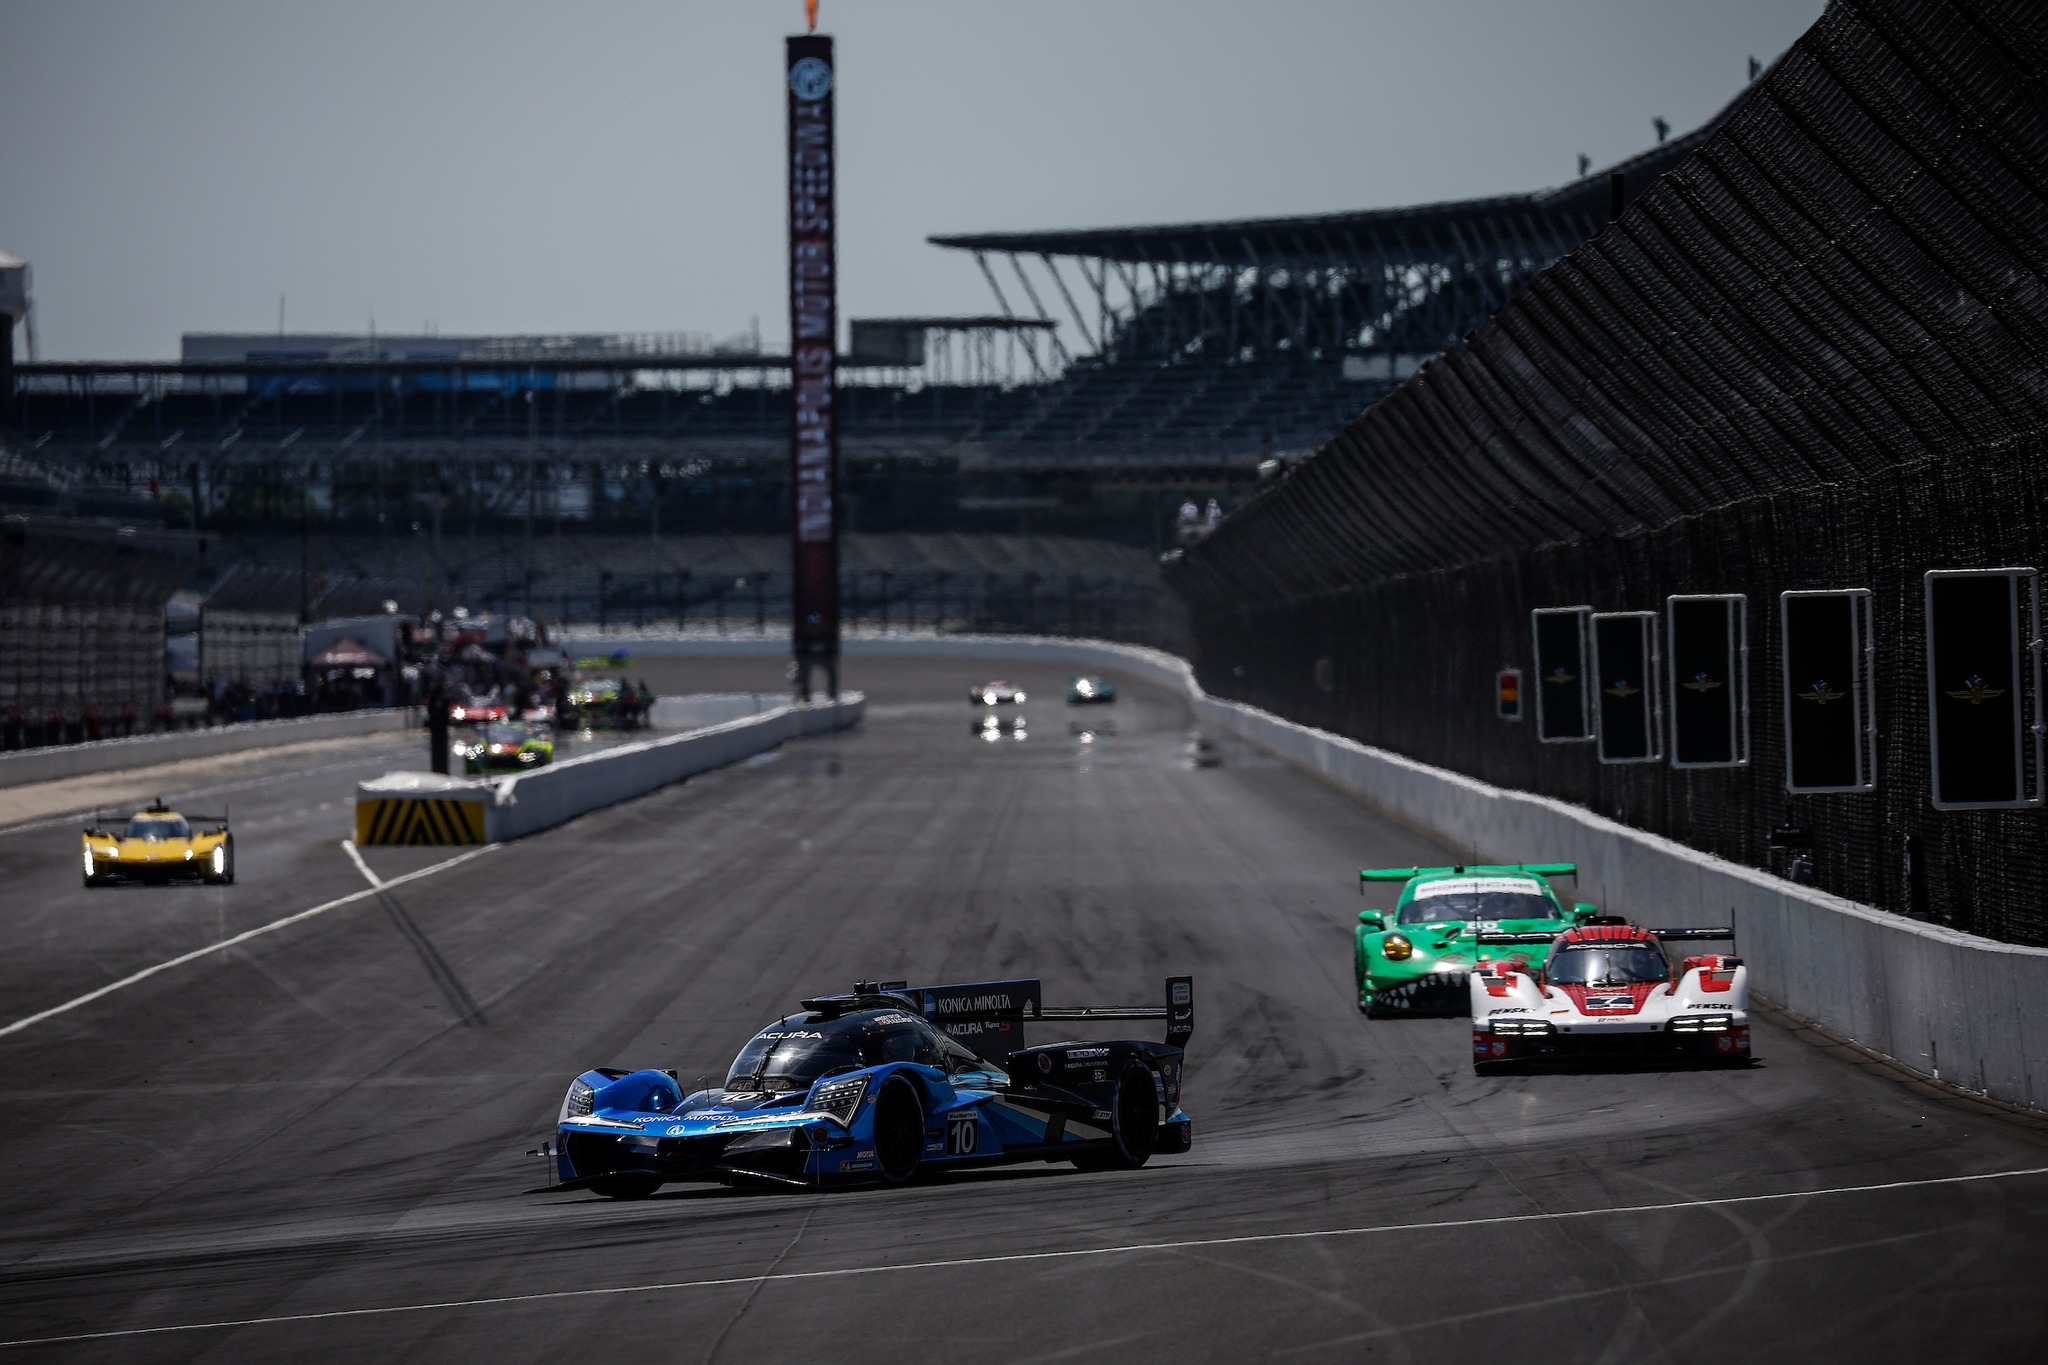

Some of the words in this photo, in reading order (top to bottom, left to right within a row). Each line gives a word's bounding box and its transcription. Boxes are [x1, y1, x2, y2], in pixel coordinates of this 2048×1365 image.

[937, 997, 973, 1014] KONICA
[974, 994, 1012, 1011] MINOLTA
[1488, 1007, 1536, 1016] PENSK
[952, 1022, 984, 1035] ACURA
[1172, 1025, 1192, 1033] ACURA
[756, 1030, 823, 1039] ACURA
[632, 1115, 681, 1123] KONICA
[951, 1121, 975, 1154] 10
[856, 1150, 874, 1159] MOTUL
